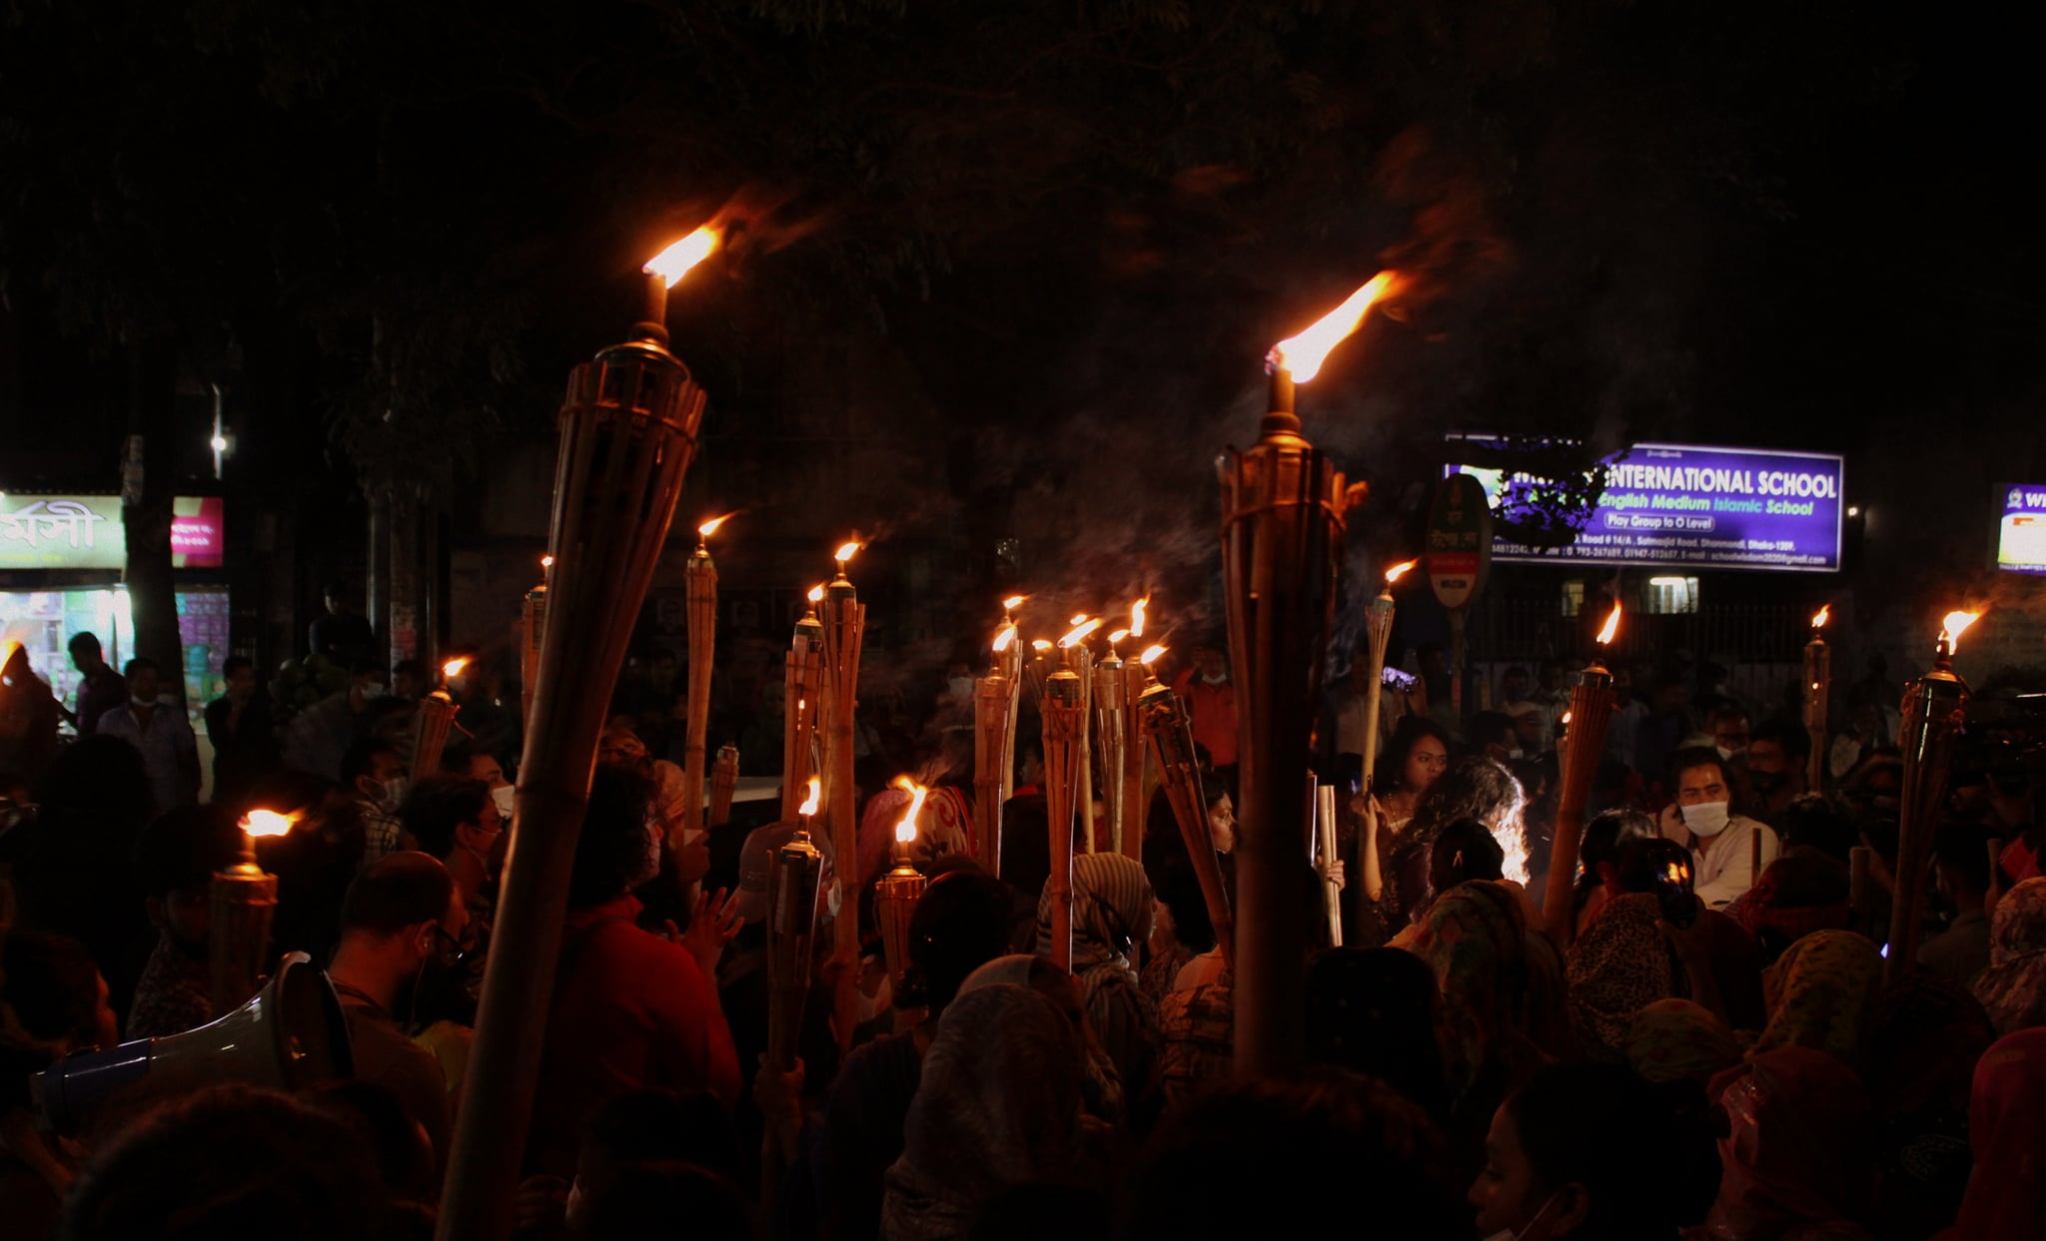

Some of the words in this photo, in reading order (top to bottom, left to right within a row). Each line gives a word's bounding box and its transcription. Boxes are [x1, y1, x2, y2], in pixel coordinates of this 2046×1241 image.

[1757, 471, 1837, 498] SCHOOL
[1598, 492, 1648, 510] English
[1651, 494, 1710, 511] Medium
[1714, 498, 1762, 513] Islamic
[1766, 499, 1814, 515] School
[1607, 513, 1629, 528] Play
[1631, 515, 1662, 529] Group
[1663, 516, 1673, 527] to
[1675, 517, 1685, 528] O
[1686, 518, 1713, 530] Level
[1582, 534, 1604, 545] Road
